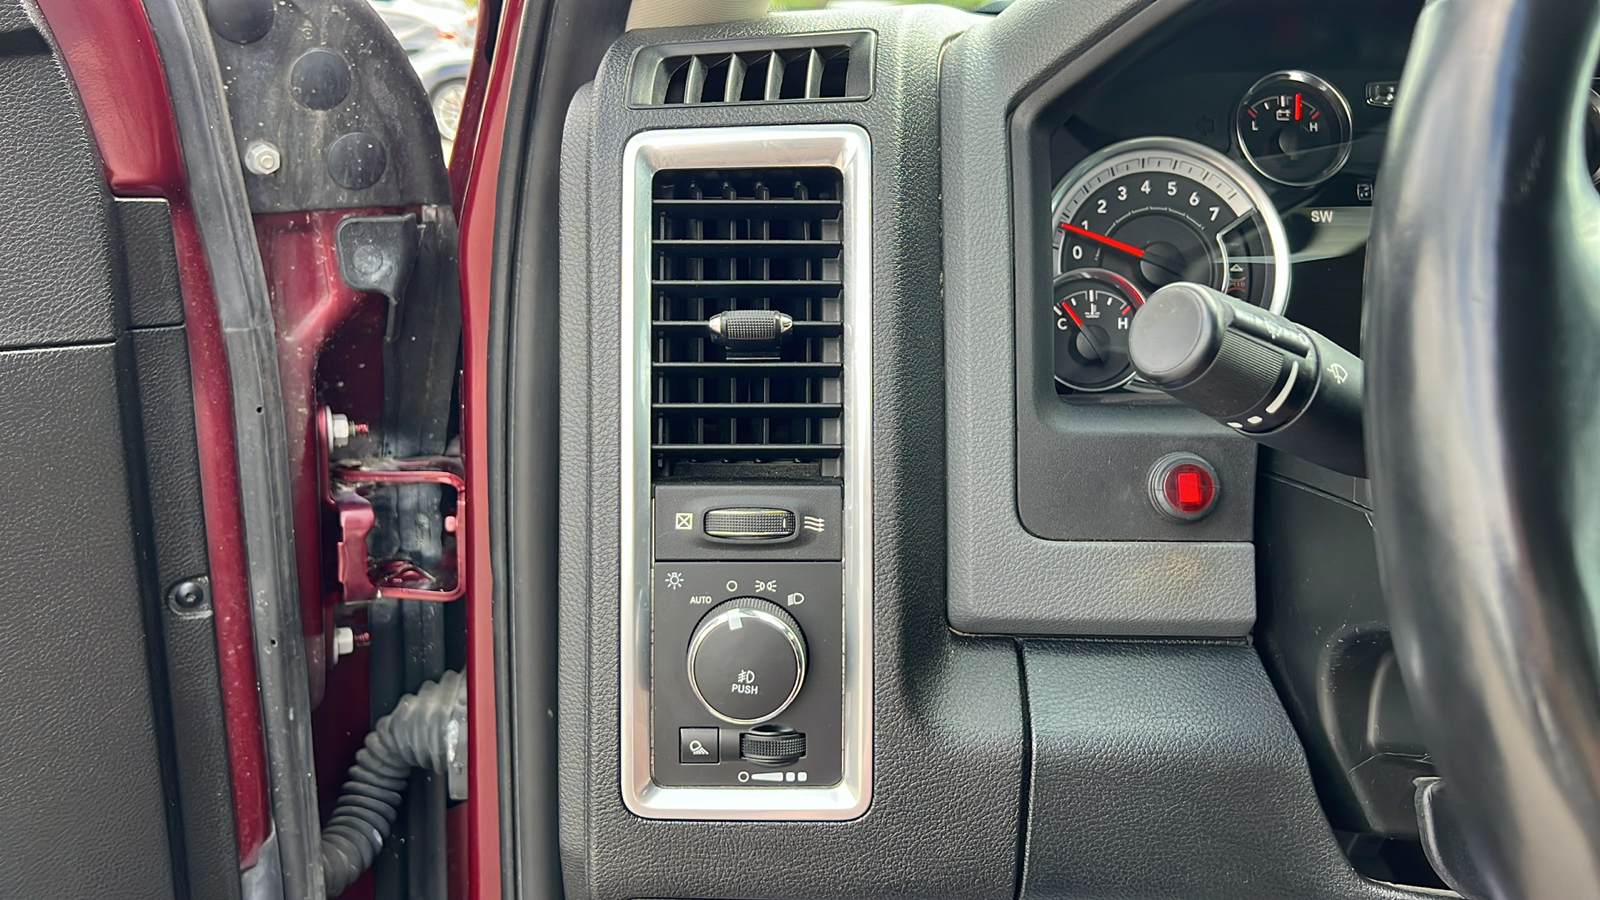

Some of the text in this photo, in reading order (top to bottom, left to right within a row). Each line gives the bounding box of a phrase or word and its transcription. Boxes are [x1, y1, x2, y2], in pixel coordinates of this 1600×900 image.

[1251, 120, 1259, 131] L
[1309, 121, 1319, 132] H
[1117, 186, 1128, 201] 3
[1140, 179, 1151, 194] 4
[1167, 181, 1178, 196] 5
[1189, 191, 1200, 206] 6
[1097, 199, 1107, 214] 2
[1209, 206, 1220, 221] 7
[1310, 210, 1334, 224] SW
[1081, 220, 1089, 231] 1
[1072, 245, 1083, 260] 0
[1057, 318, 1068, 331] C
[1117, 317, 1129, 330] H
[690, 596, 712, 604] AUTO
[731, 684, 758, 695] PUSH
